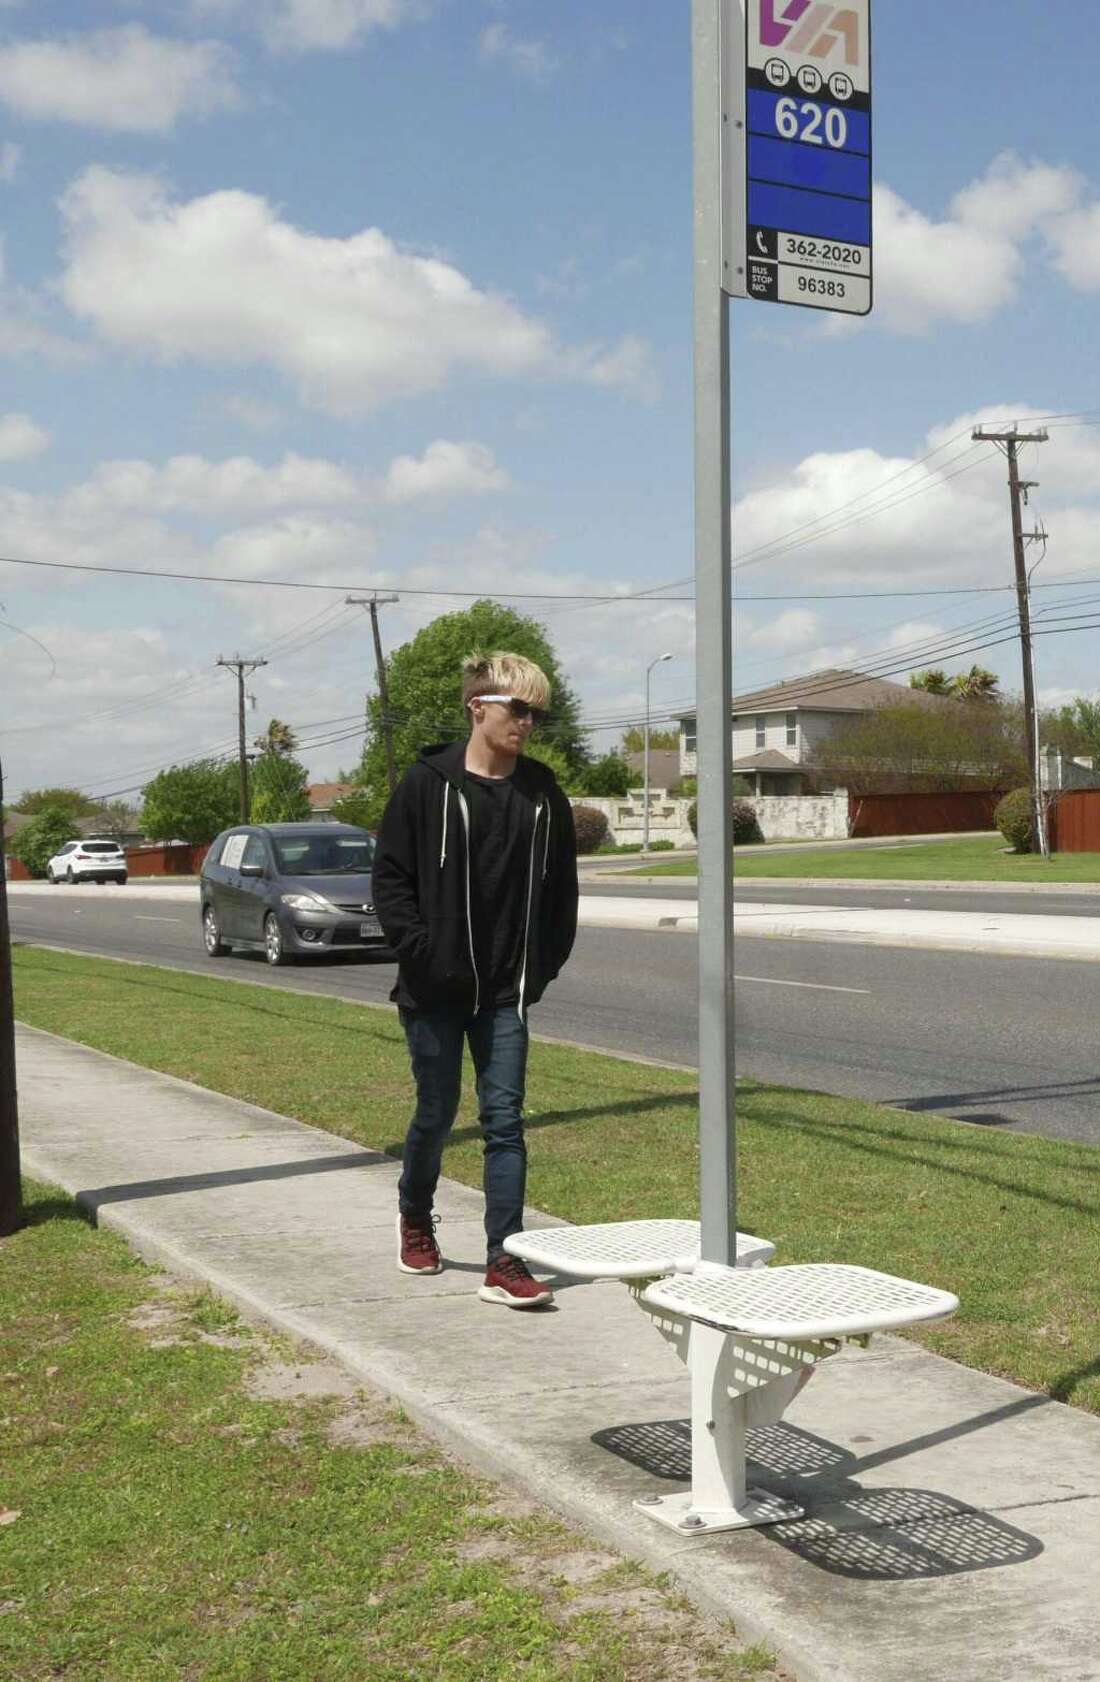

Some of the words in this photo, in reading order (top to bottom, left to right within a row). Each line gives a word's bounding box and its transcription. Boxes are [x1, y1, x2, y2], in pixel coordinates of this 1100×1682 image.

[759, 0, 859, 66] VIA
[775, 97, 847, 148] 620
[786, 239, 862, 264] 362-2020
[752, 265, 768, 275] BUS
[752, 275, 773, 284] STOP
[797, 276, 846, 298] 96383
